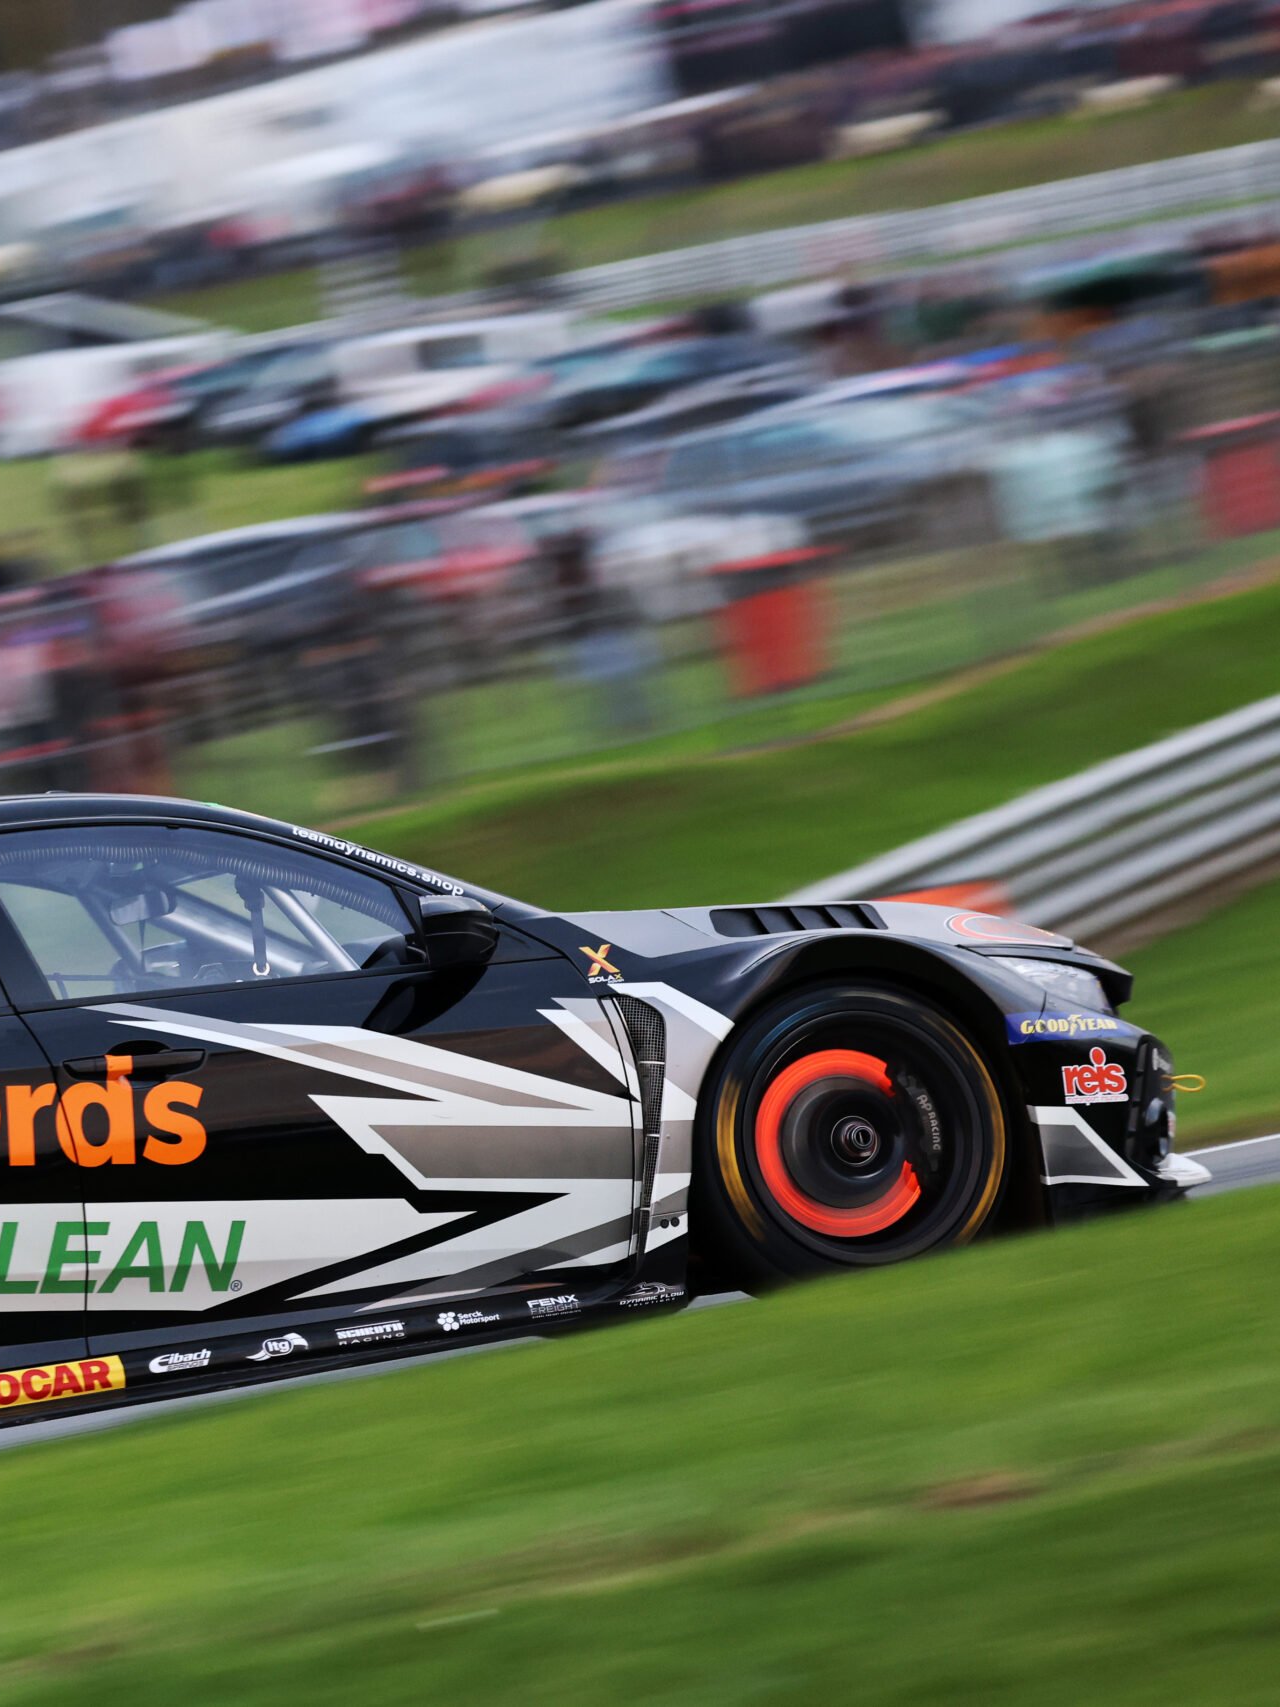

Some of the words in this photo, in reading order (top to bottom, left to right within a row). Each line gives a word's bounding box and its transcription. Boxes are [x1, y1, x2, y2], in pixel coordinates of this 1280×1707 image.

[292, 827, 464, 896] teamdynamics.shop
[1020, 1014, 1118, 1036] GOODYEAR
[1061, 1047, 1128, 1096] reis
[526, 1294, 579, 1308] FENIX
[457, 1310, 483, 1320] Serck
[530, 1302, 580, 1316] FREIGHT
[459, 1313, 501, 1325] Motorsport
[338, 1331, 406, 1346] RACING
